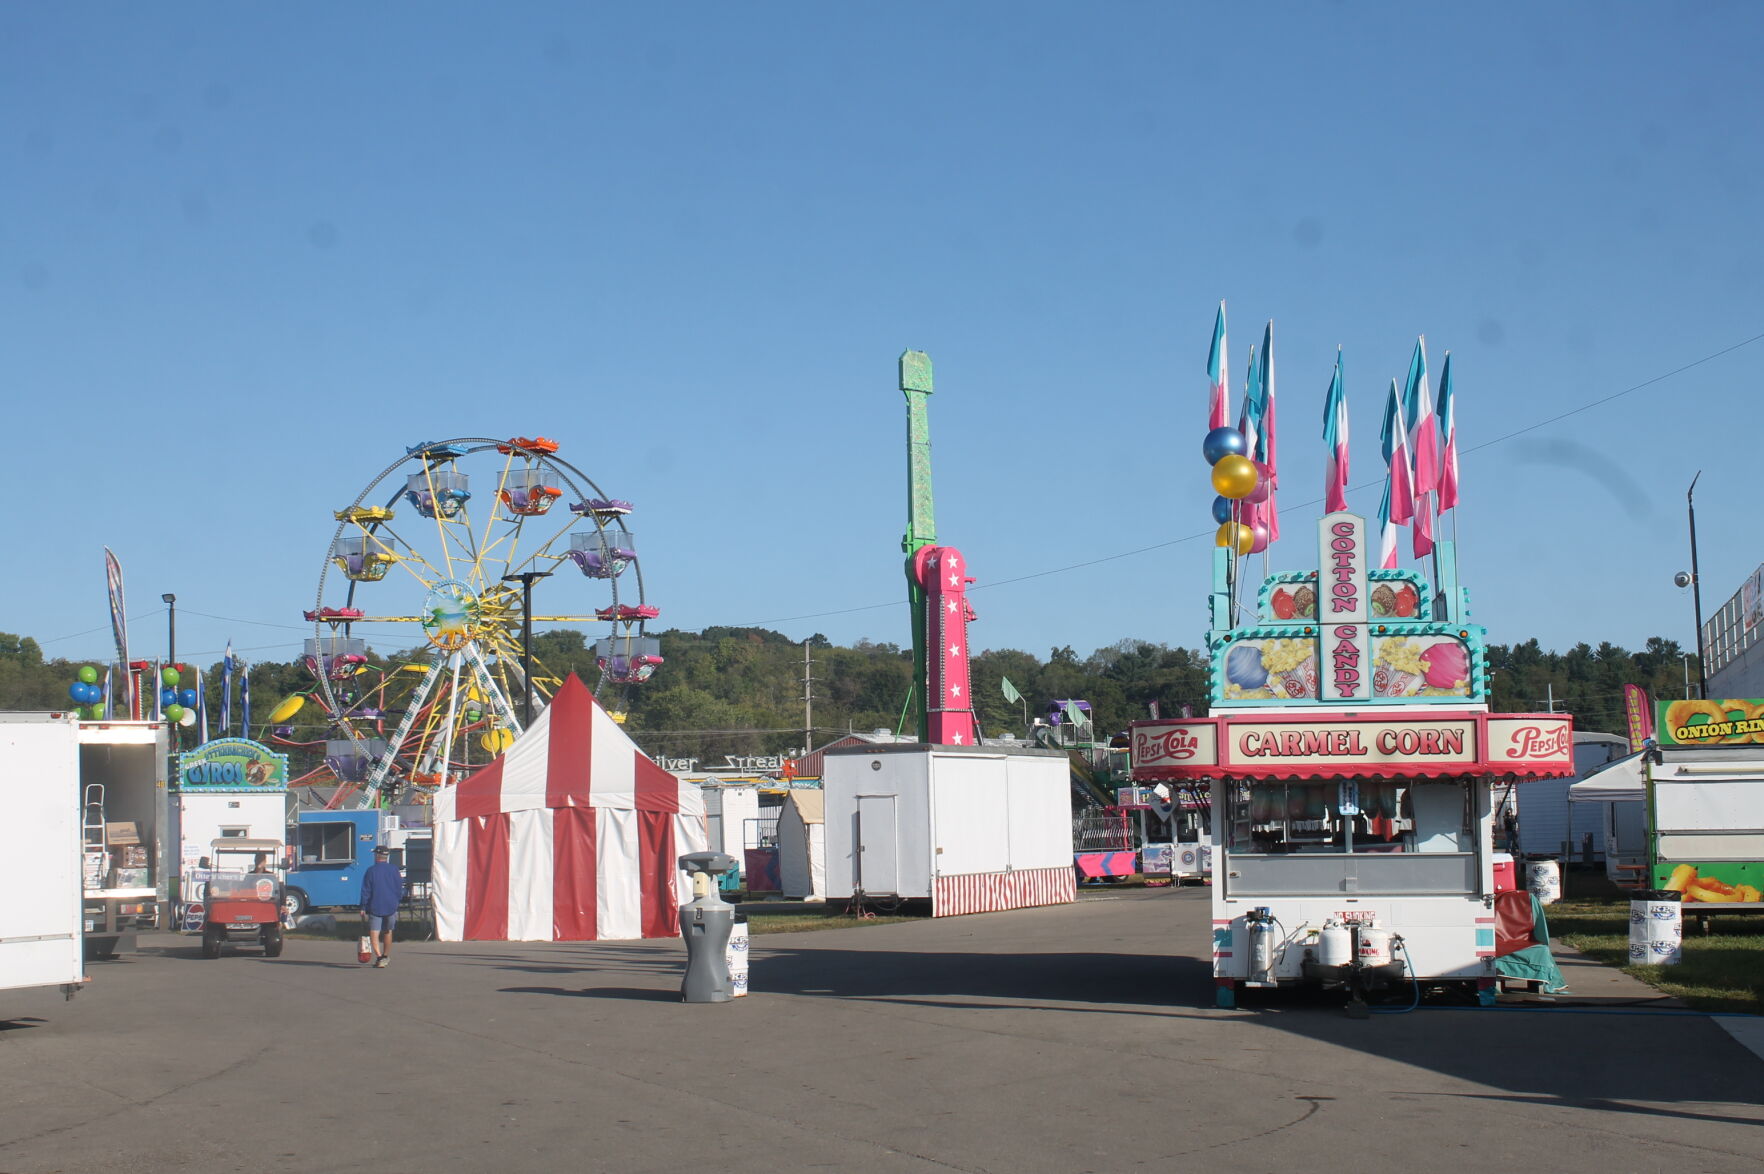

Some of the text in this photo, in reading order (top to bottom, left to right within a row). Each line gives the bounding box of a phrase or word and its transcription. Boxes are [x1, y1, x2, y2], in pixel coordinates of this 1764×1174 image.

[1331, 522, 1361, 698] COTTON CANDY
[1239, 728, 1464, 757] CARMEL CORN
[1675, 721, 1733, 740] ONION
[187, 761, 243, 785] GYROS
[654, 755, 698, 770] ilver
